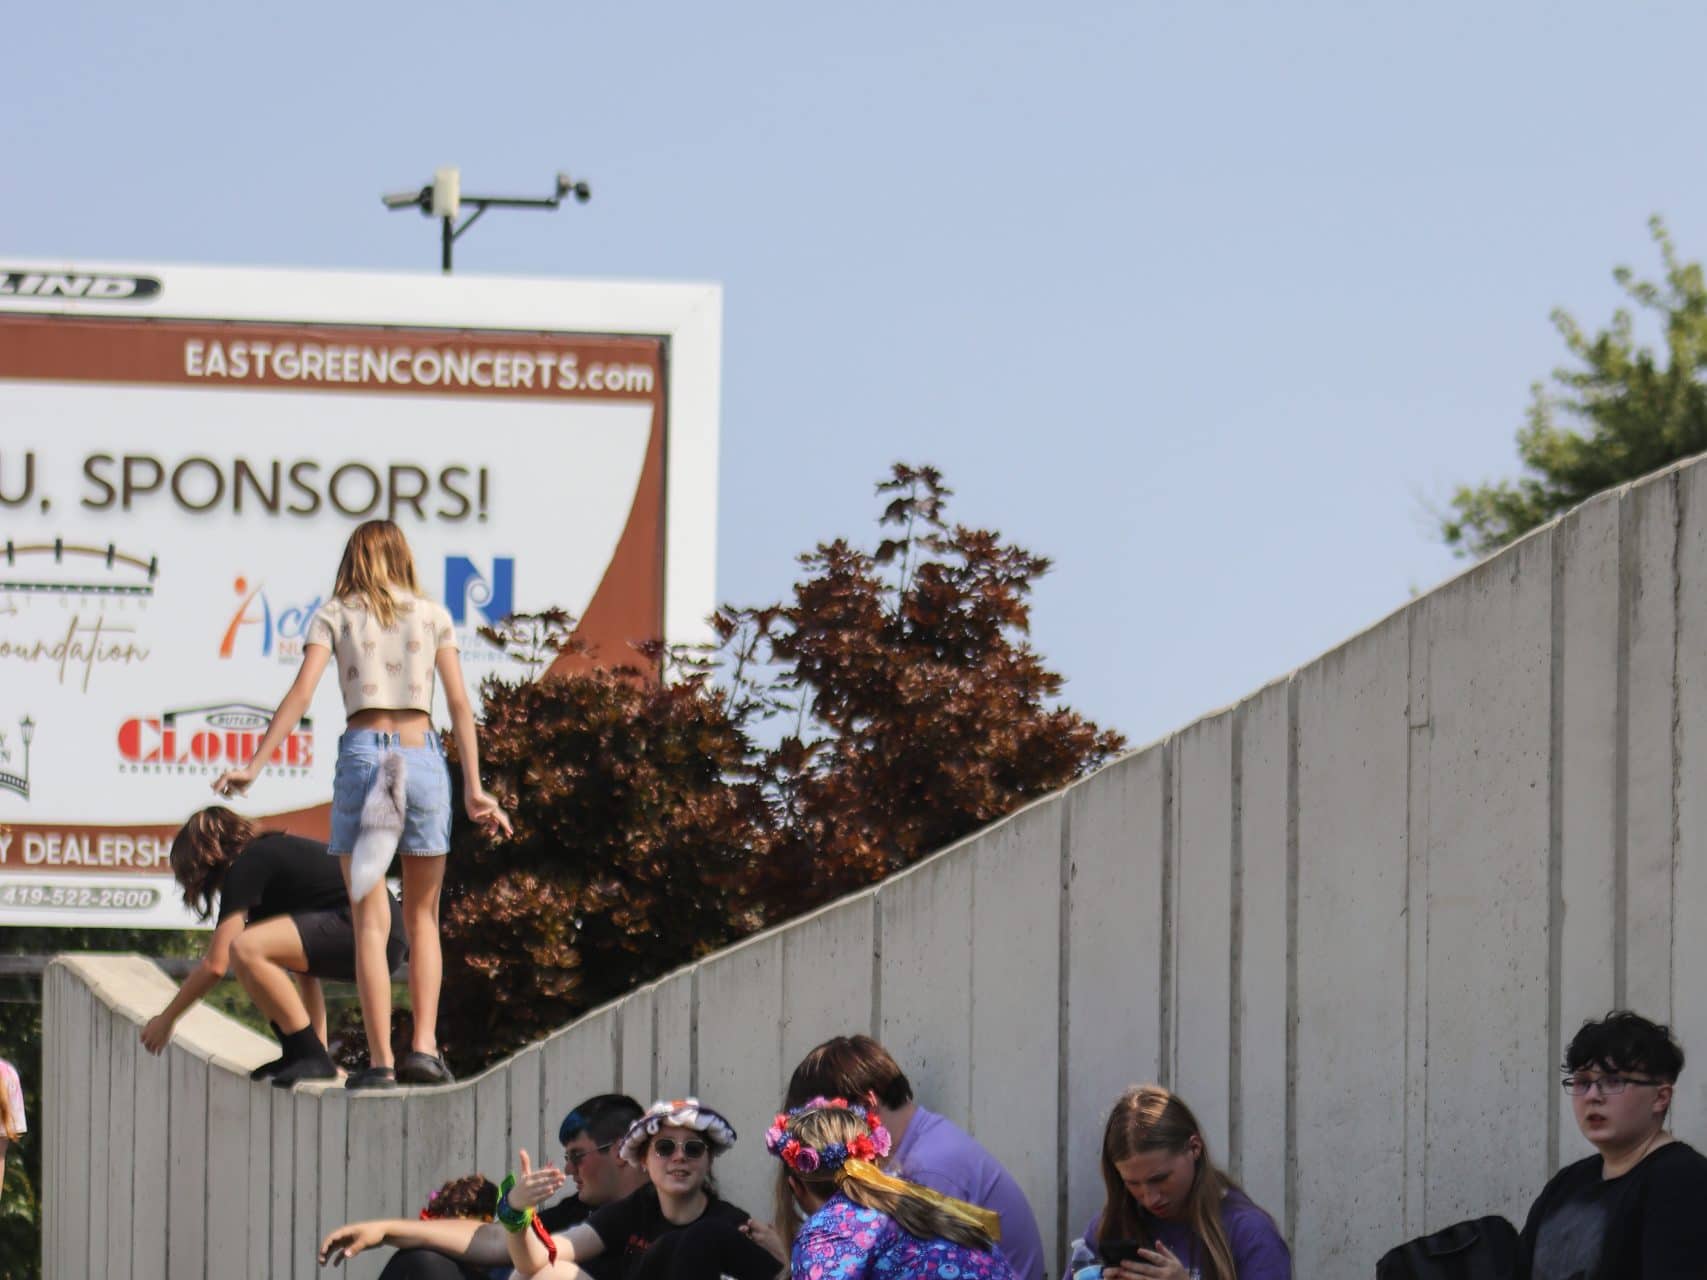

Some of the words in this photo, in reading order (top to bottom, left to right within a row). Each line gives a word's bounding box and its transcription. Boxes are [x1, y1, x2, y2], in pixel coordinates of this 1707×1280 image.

[185, 340, 653, 392] EASTGREENCONCERTS.com
[81, 454, 488, 522] SPONSORS!
[4, 886, 152, 907] 419-522-2600
